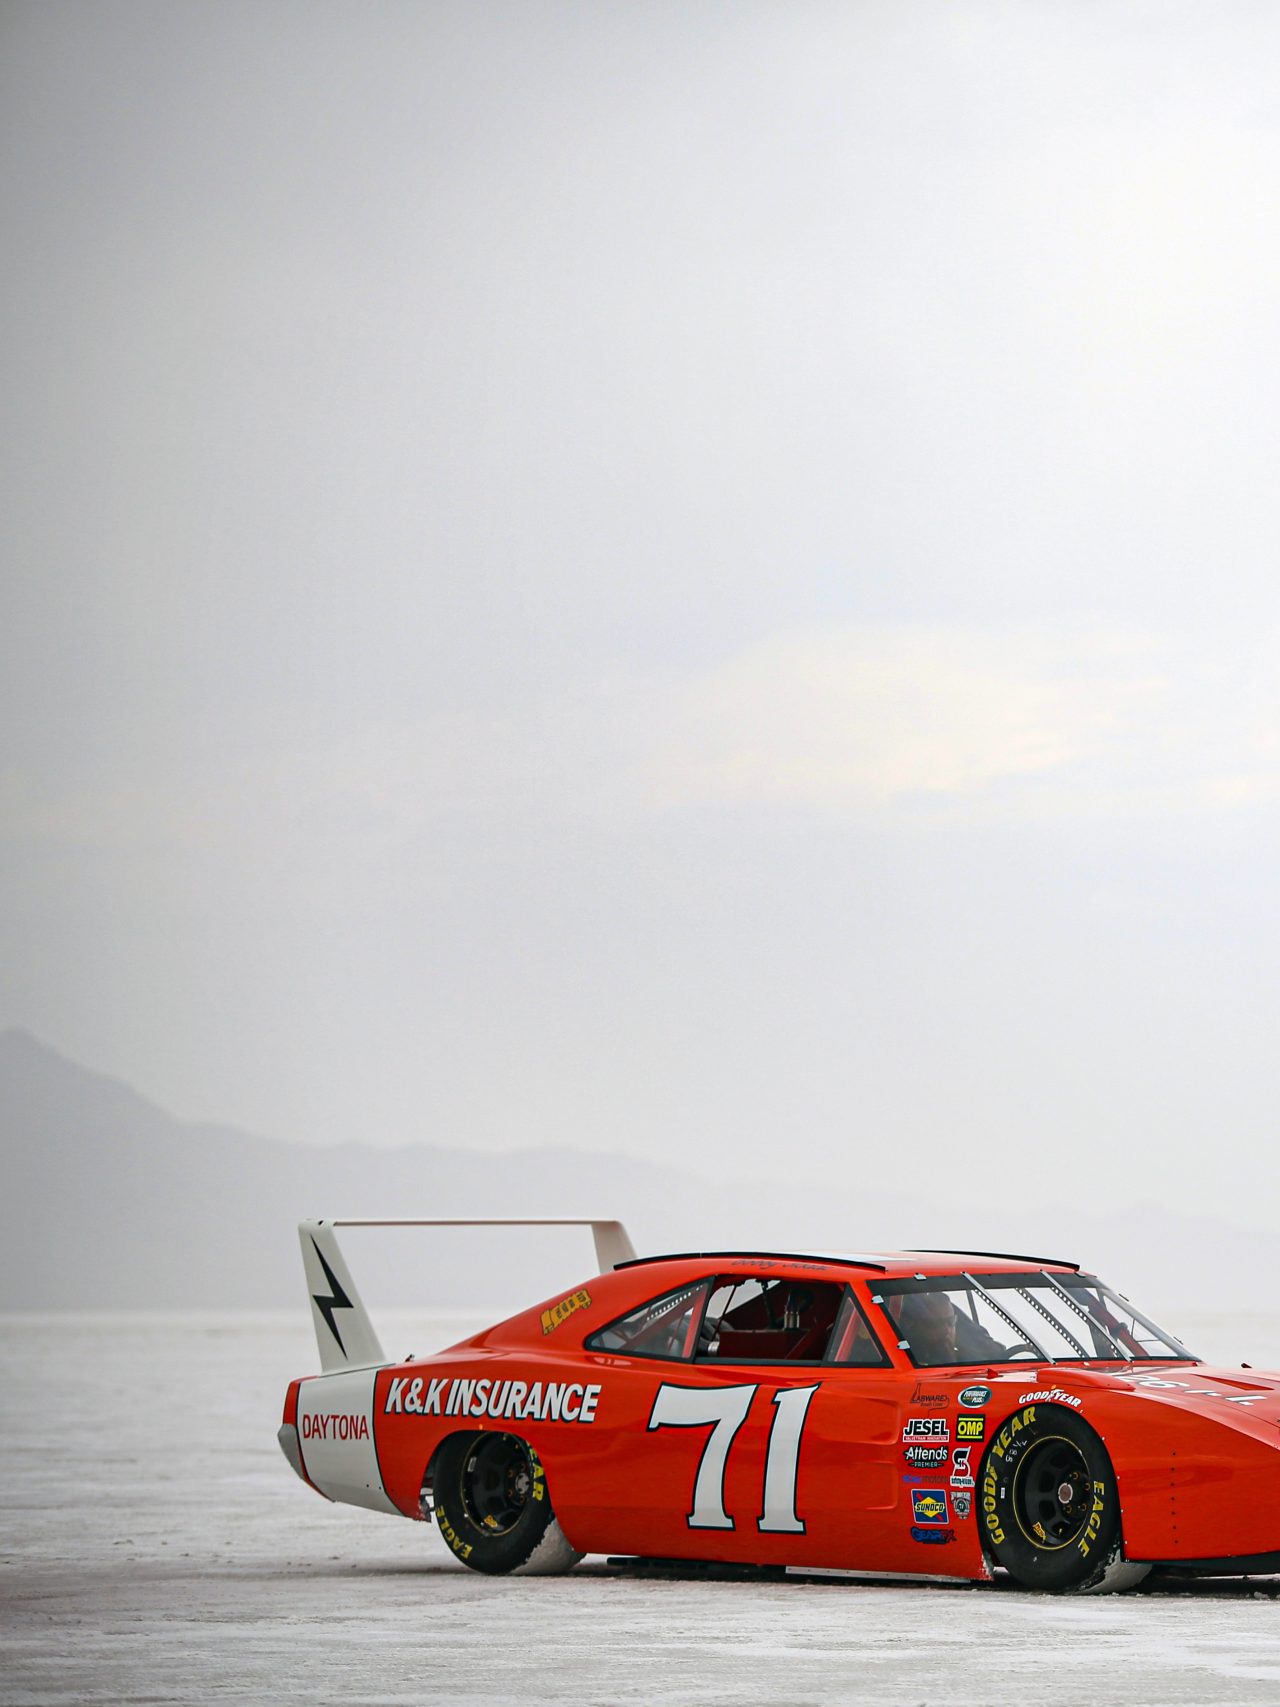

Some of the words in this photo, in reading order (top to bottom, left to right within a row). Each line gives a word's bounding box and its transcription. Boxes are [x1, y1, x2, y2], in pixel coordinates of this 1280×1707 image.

[384, 1377, 447, 1416] K&K
[446, 1378, 602, 1423] INSURANCE
[1018, 1389, 1082, 1407] GOODYEAR
[302, 1414, 369, 1441] DAYTONA
[904, 1420, 949, 1436] JESEL
[957, 1421, 983, 1436] OMP
[646, 1381, 822, 1535] 71
[905, 1446, 948, 1460] Attends
[983, 1406, 1036, 1545] GOODYEAR
[915, 1502, 945, 1512] SUNOCO
[1077, 1480, 1105, 1558] EAGLE
[434, 1505, 473, 1559] EAGLE
